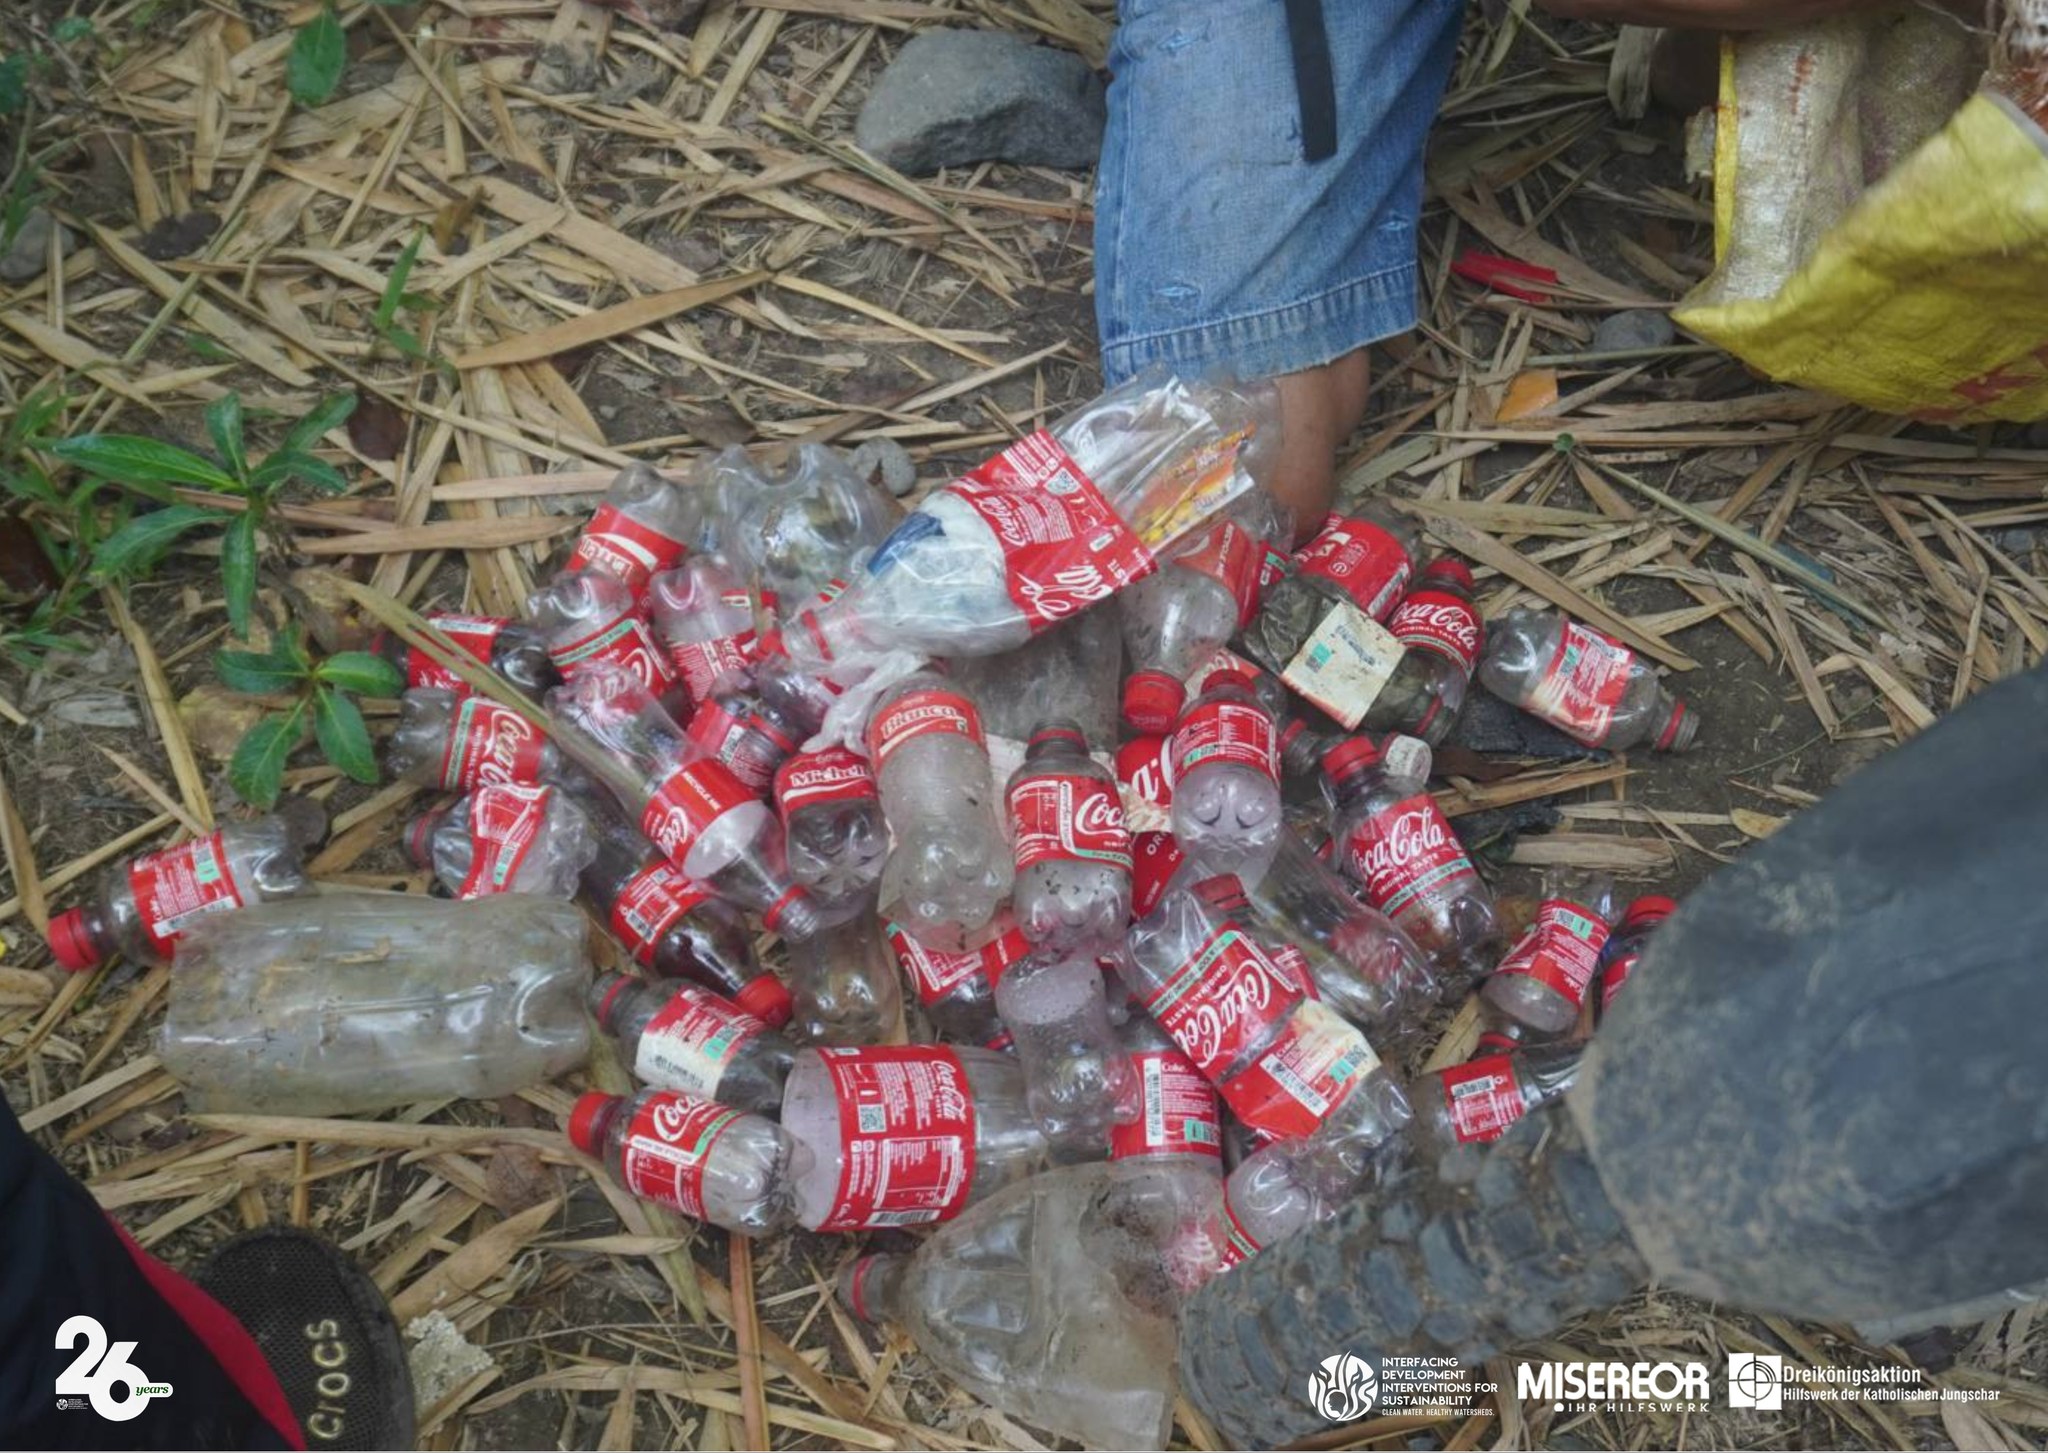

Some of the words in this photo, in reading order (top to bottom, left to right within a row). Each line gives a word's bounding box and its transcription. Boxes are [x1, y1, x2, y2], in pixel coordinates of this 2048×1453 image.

[1190, 964, 1227, 1003] ORIGINAL
[1165, 1001, 1193, 1028] TASTE
[1173, 959, 1270, 1069] Coca-Col
